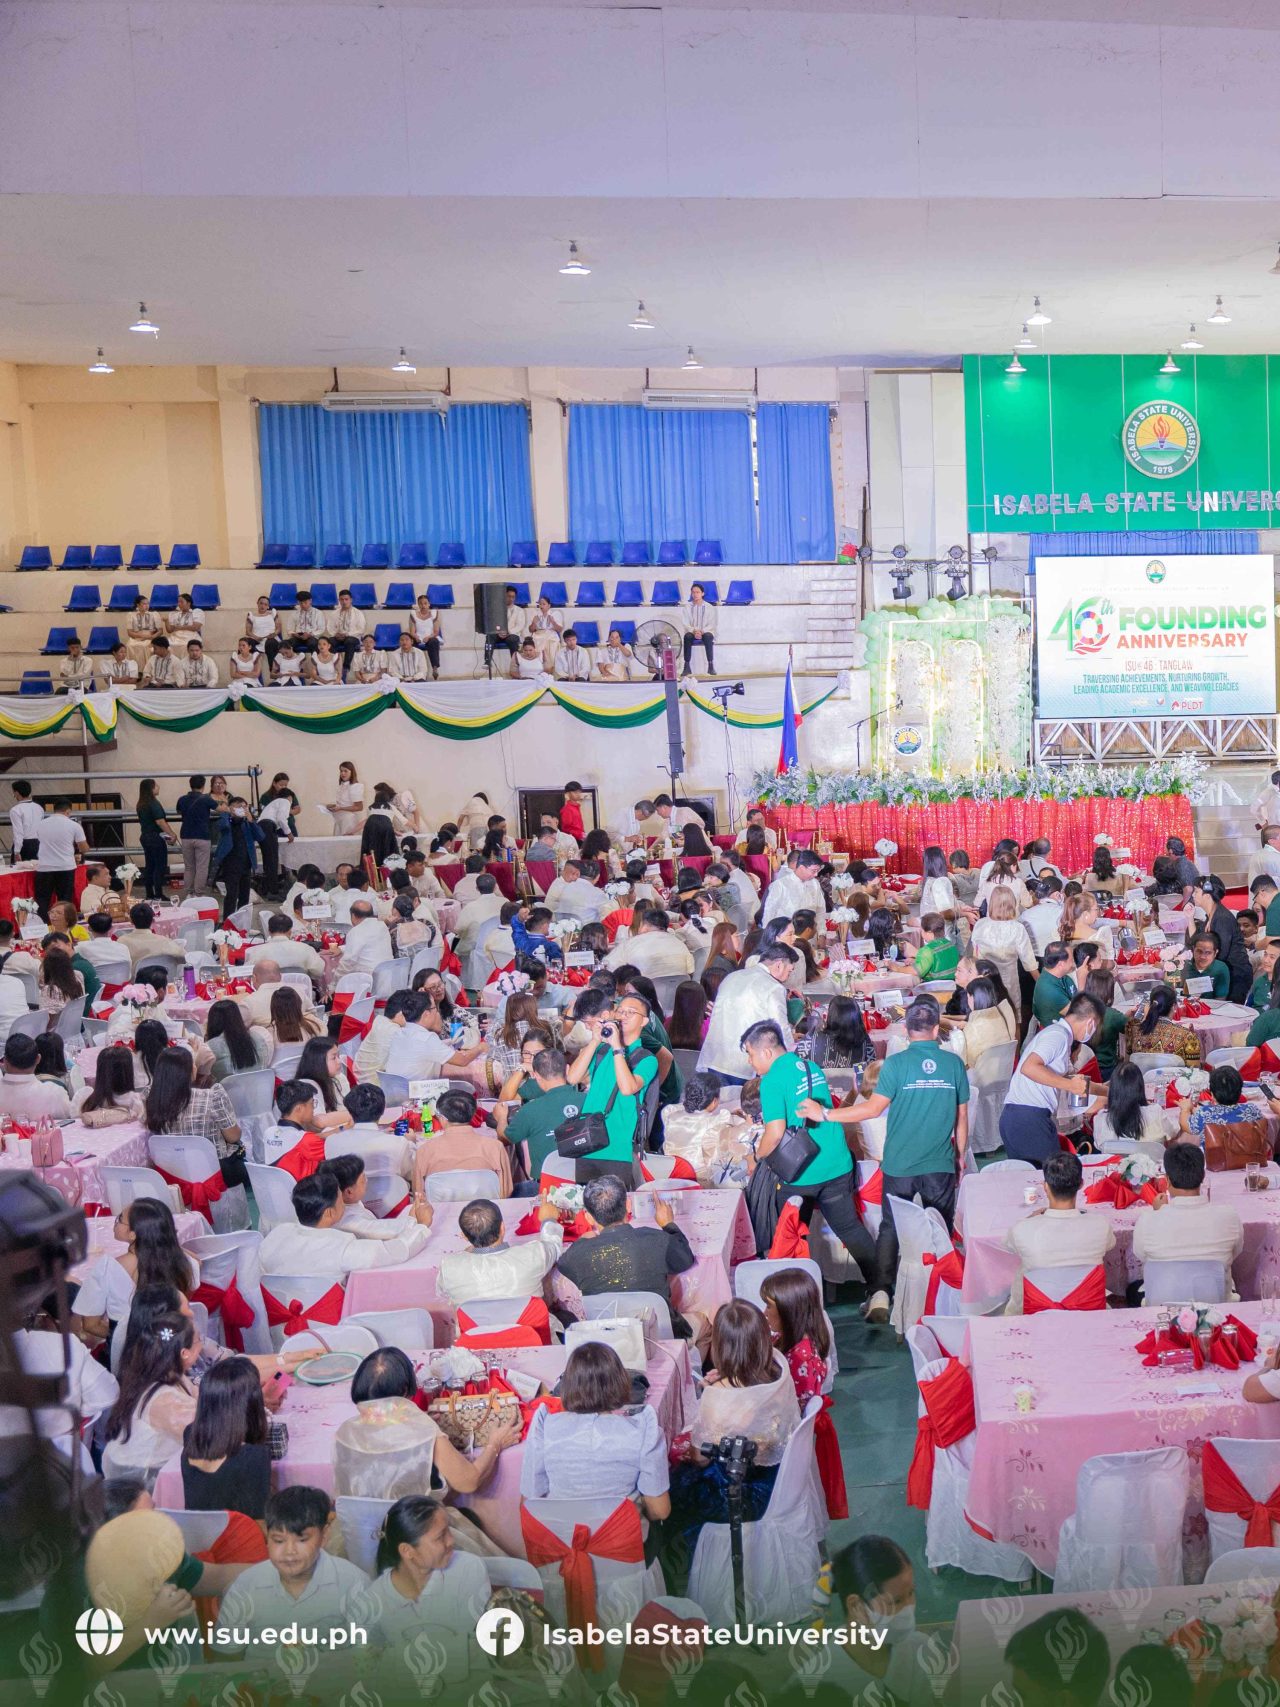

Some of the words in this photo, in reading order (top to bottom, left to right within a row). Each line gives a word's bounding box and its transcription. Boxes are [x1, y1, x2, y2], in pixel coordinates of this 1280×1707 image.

[1128, 420, 1142, 462] ISABELA
[1138, 405, 1168, 421] STATE
[1170, 407, 1196, 462] UNIVERSITY
[1152, 465, 1174, 474] 1978
[994, 493, 1094, 516] ISABELA
[1105, 491, 1176, 513] STATE
[1118, 605, 1267, 631] FOUNDING
[1116, 632, 1249, 649] ANNIVERSARY
[1159, 659, 1193, 671] TANGLAW
[1083, 674, 1120, 684] TRAVERSING
[1168, 672, 1201, 682] NURTURING
[1074, 684, 1100, 695] LEADING
[1100, 684, 1131, 694] ACADEMIC
[1171, 683, 1183, 692] AND
[1184, 682, 1212, 692] WEAVING
[1181, 701, 1203, 710] PLDT
[574, 1137, 587, 1146] EOS
